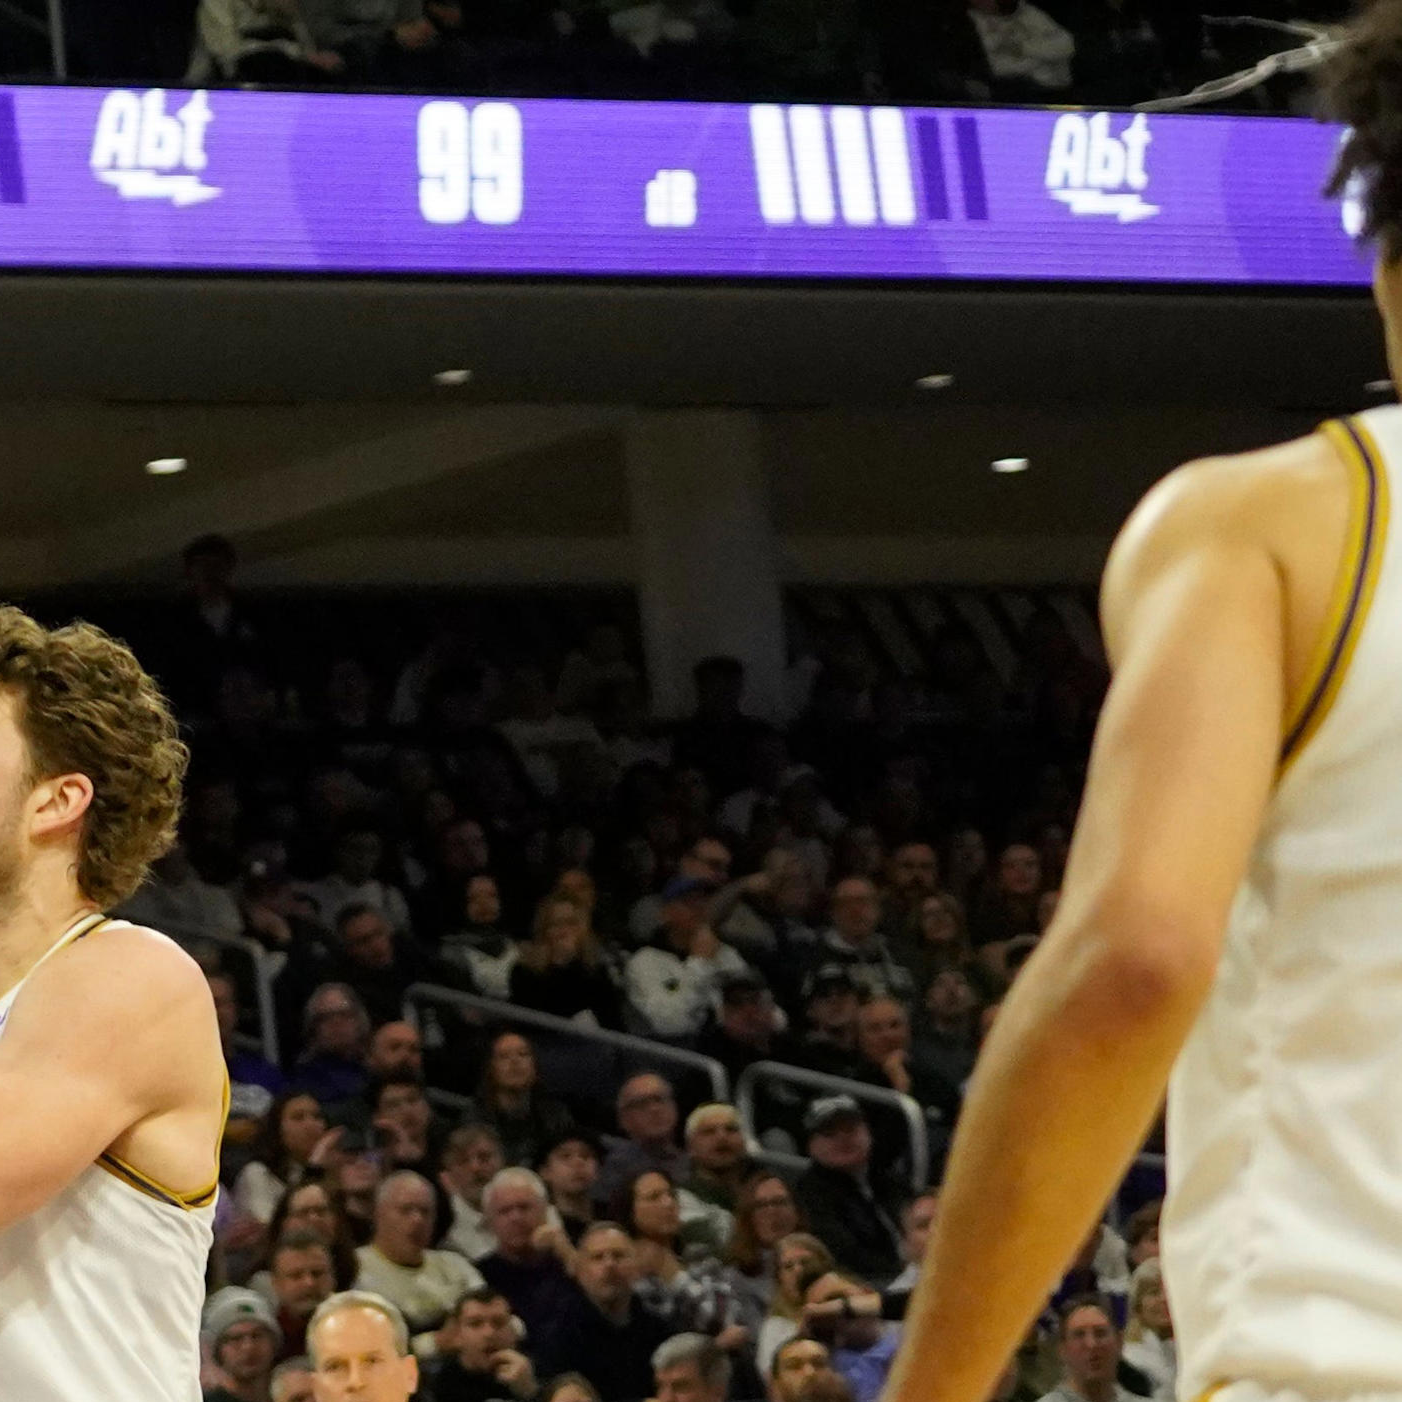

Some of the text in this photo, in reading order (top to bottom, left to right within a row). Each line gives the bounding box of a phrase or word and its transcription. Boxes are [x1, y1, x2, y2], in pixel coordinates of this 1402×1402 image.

[90, 88, 215, 171] Abt
[417, 101, 523, 224] 99
[1045, 111, 1152, 190] Abt
